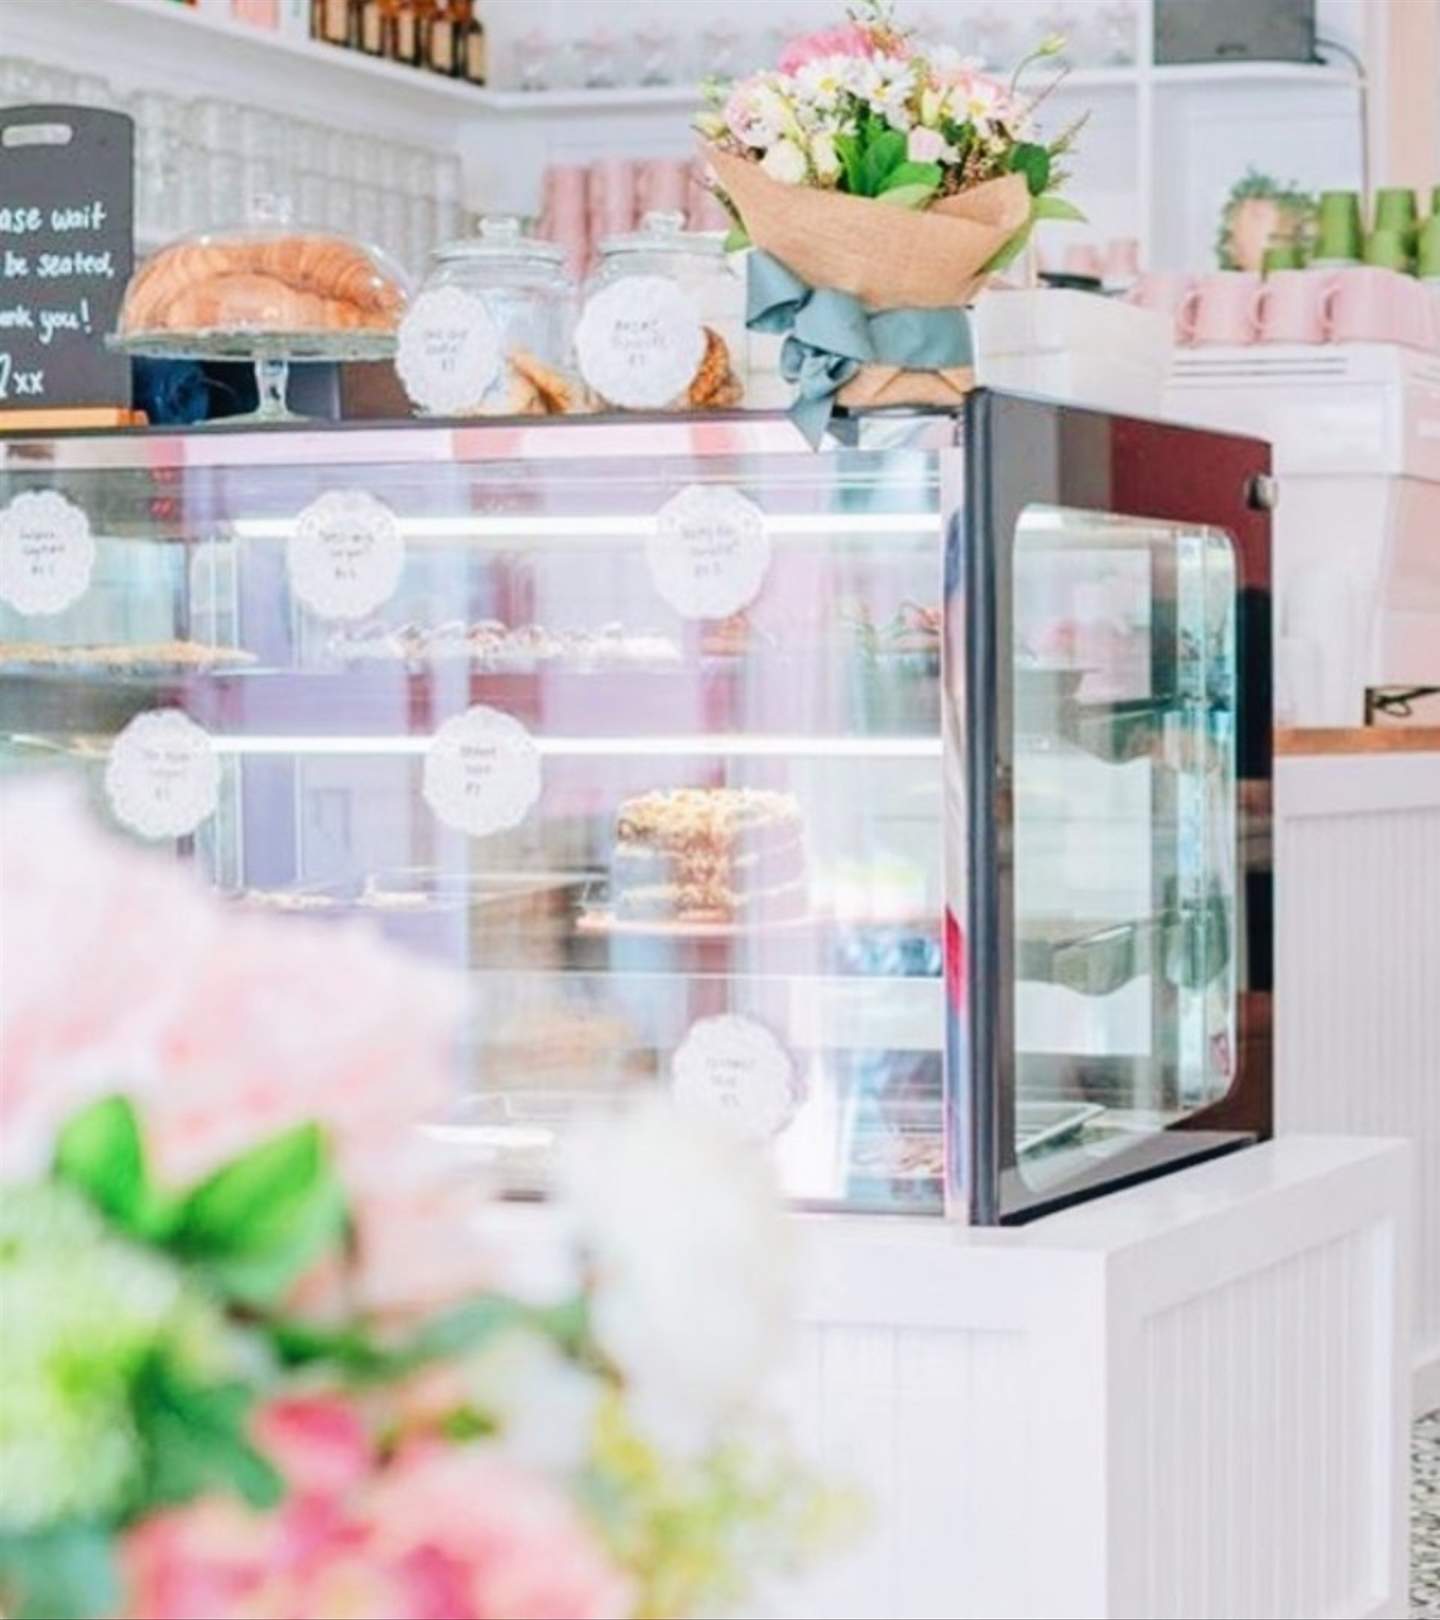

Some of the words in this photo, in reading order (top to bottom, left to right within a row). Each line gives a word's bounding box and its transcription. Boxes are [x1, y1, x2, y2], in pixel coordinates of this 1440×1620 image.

[51, 201, 106, 231] wait
[5, 250, 29, 277] be
[37, 251, 114, 277] seated,
[39, 299, 92, 344] you!
